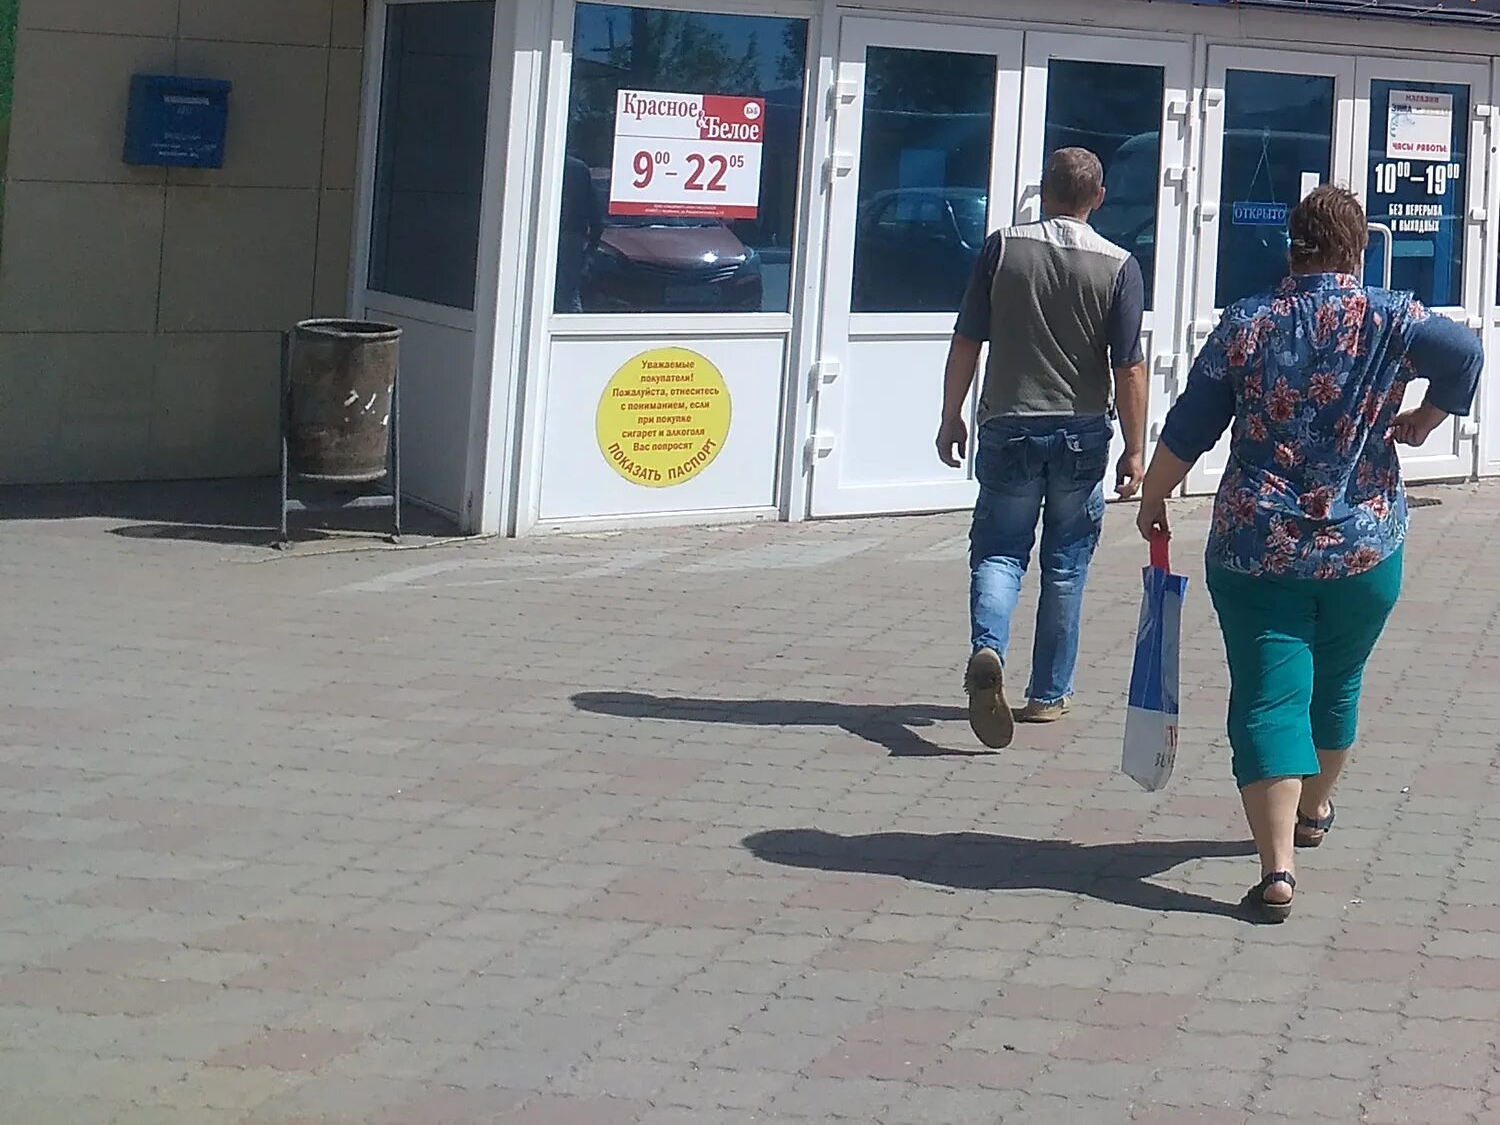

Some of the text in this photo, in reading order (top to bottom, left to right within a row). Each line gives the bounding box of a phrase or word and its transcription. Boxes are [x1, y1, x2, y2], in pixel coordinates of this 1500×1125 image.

[623, 92, 698, 120] Красное
[705, 116, 760, 141] Белое
[1392, 142, 1414, 151] ЧАСЫ
[1234, 206, 1286, 220] ОТКРЫТО
[1389, 203, 1443, 216] БЕЗ ПЕРЕРЫВА
[1399, 219, 1440, 234] ВЫХОДНЫХ
[641, 360, 695, 369] Уважаемые
[640, 373, 694, 384] покупатели!
[612, 387, 720, 399] Пожалуйста, отнеситесь
[628, 402, 688, 411] пониманием,
[690, 401, 710, 409] если
[637, 414, 692, 425] при покупке
[622, 430, 657, 439] сигарет
[666, 428, 705, 436] алкоголя
[633, 442, 693, 452] Вас попросят
[608, 438, 717, 482] ПОКАЗАТЬ ПАСПОРТ
